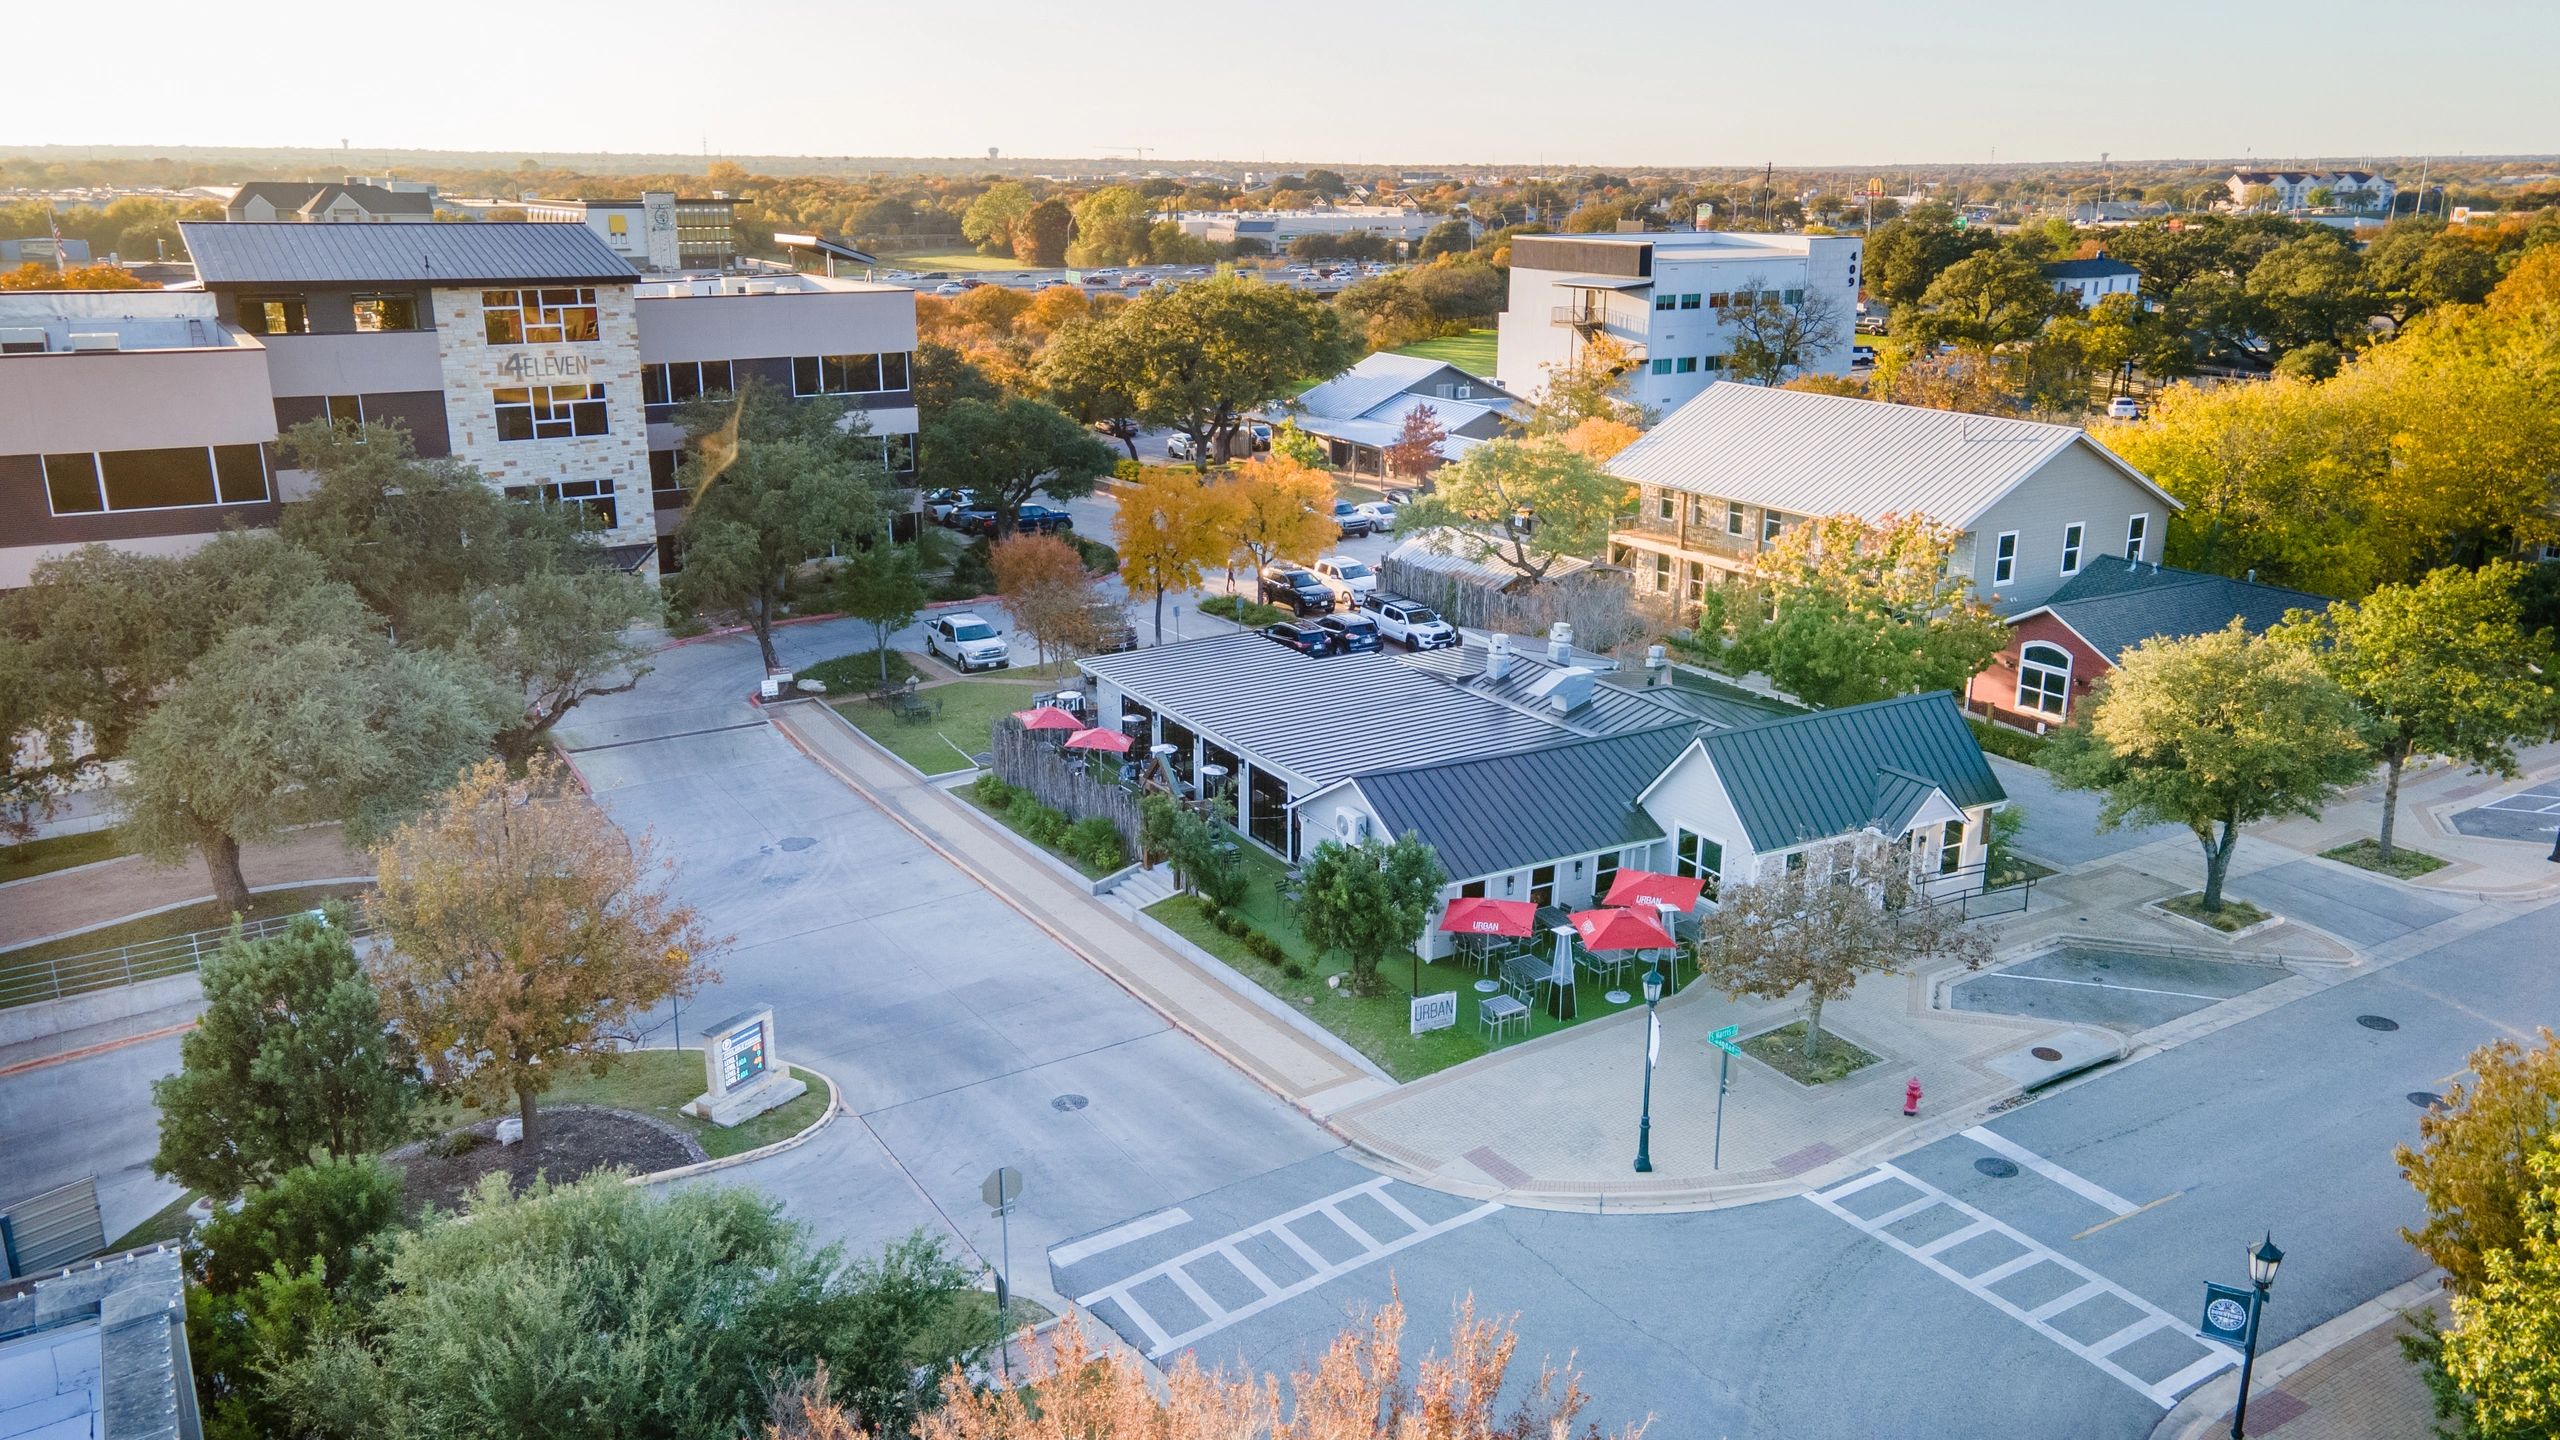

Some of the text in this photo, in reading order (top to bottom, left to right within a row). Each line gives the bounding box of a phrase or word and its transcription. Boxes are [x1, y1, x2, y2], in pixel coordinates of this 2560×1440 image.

[1848, 252, 1857, 287] 409
[505, 352, 588, 379] 4ELEVEN
[1636, 894, 1662, 905] URBAN
[1472, 920, 1499, 931] URBAN
[1414, 999, 1454, 1022] URBAN
